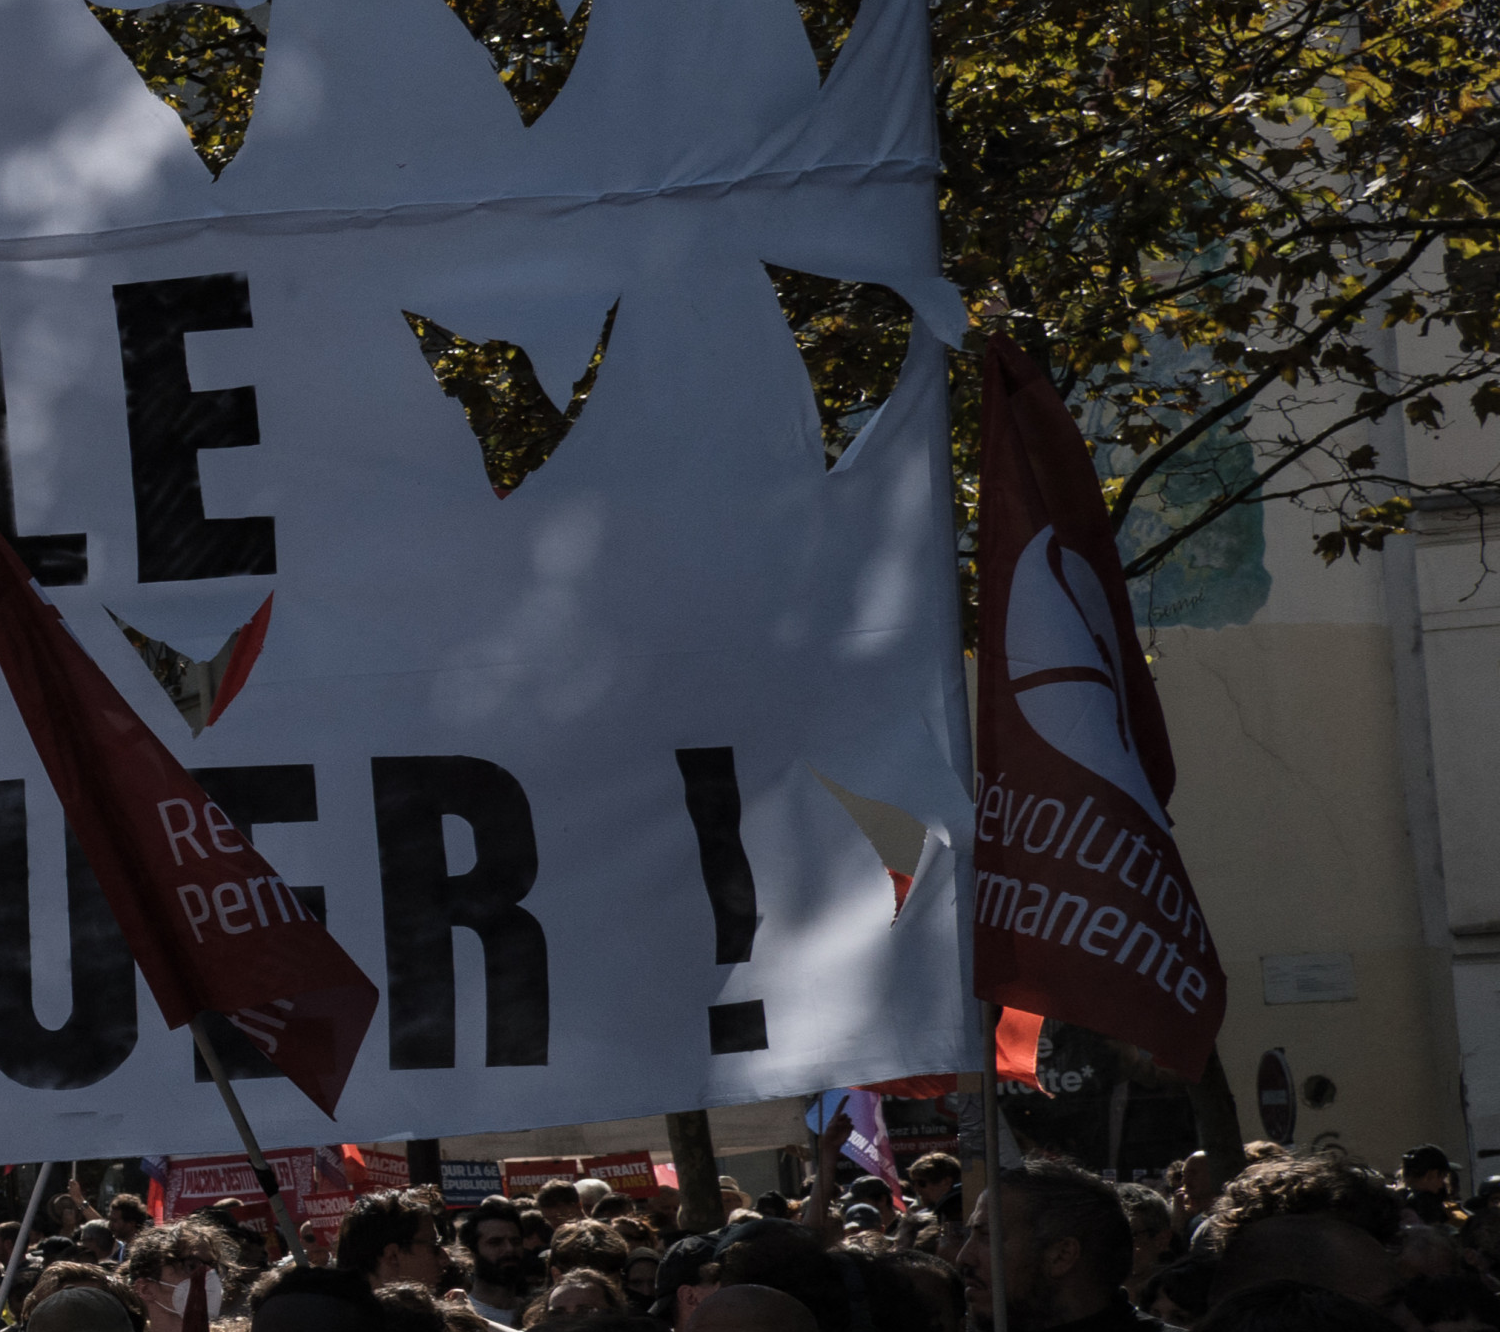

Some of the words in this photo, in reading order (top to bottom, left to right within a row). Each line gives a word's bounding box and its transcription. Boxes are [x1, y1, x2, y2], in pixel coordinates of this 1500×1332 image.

[675, 746, 769, 1055] !
[441, 1163, 464, 1177] OUR
[466, 1163, 482, 1177] LA
[588, 1161, 649, 1180] RETRAITE
[442, 1178, 501, 1191] ÉPUBLIQUE
[622, 1175, 647, 1189] ANS
